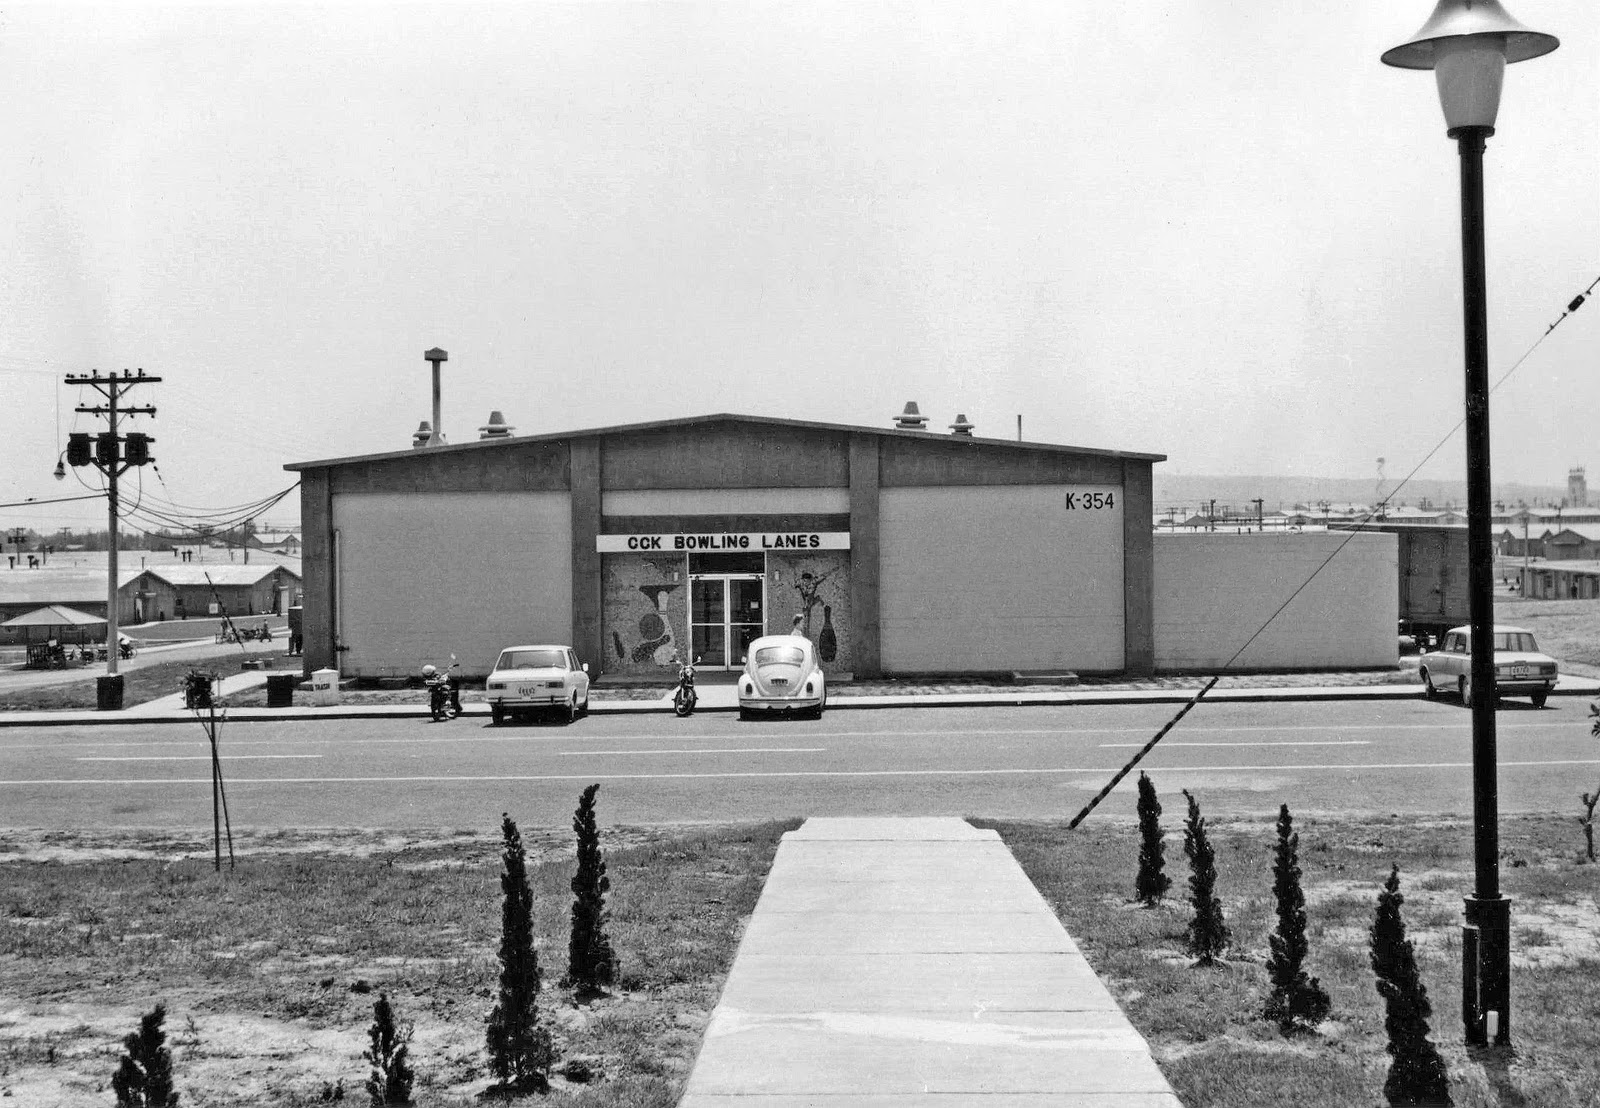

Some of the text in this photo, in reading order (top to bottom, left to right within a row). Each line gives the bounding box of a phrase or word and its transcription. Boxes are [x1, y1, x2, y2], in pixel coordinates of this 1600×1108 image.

[1066, 492, 1114, 510] K-354
[627, 534, 820, 550] CCK BOWLING LANES
